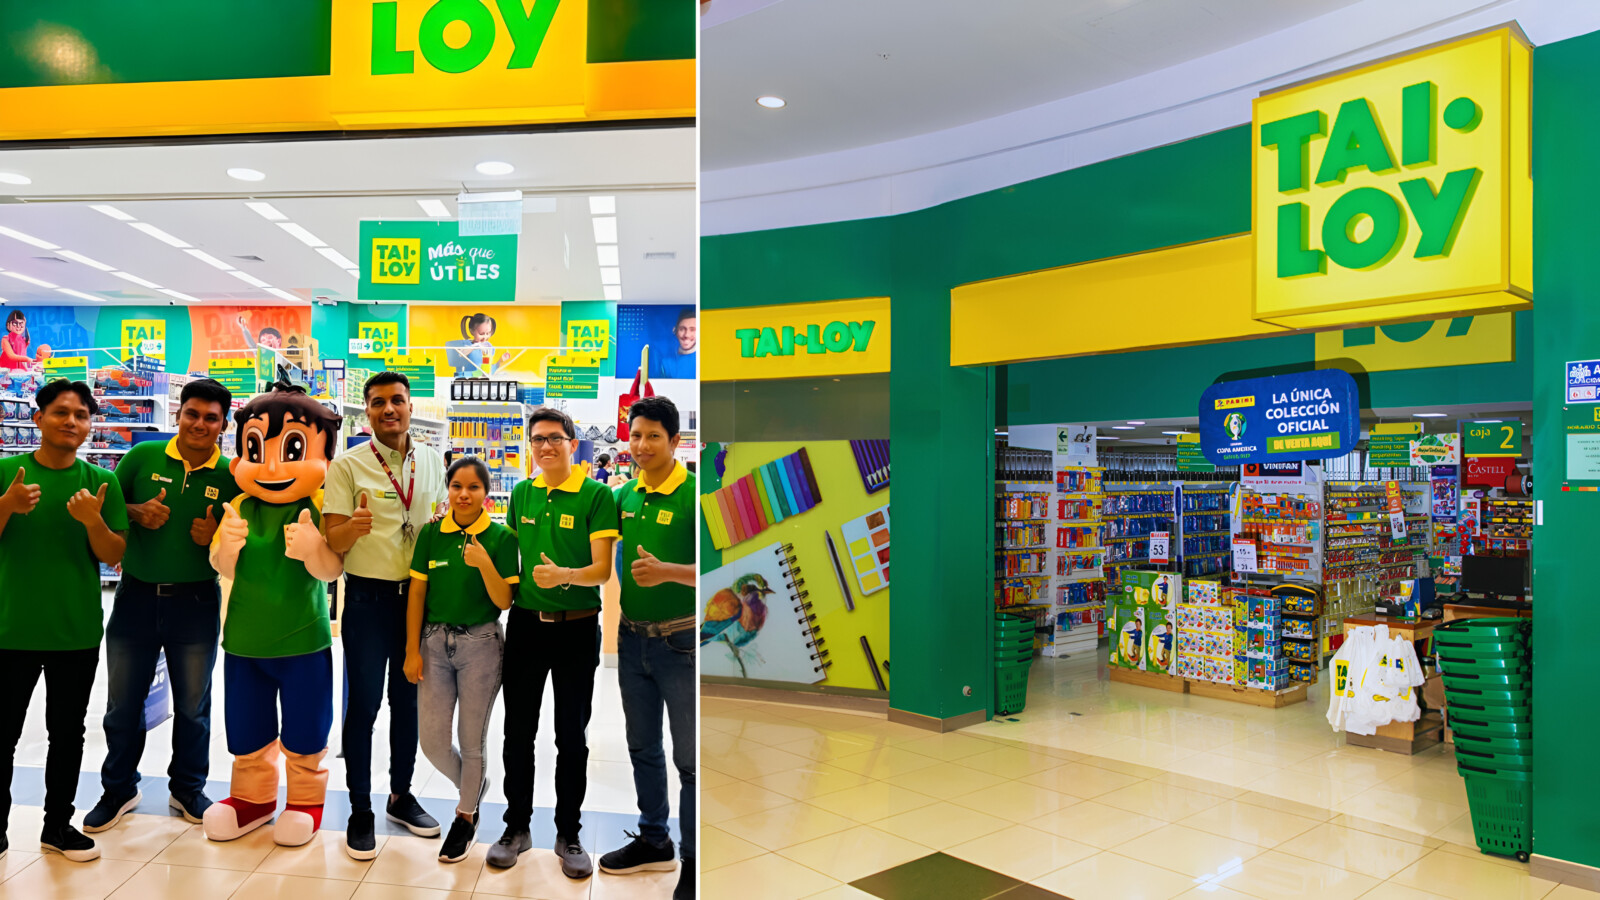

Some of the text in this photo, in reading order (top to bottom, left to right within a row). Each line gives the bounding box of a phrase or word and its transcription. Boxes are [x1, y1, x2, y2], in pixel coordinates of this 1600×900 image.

[371, 0, 560, 75] LOY
[1277, 167, 1484, 281] LOY
[427, 241, 496, 265] Más que
[379, 261, 416, 277] LOY
[373, 340, 393, 353] OY
[573, 340, 604, 352] LOY
[1225, 397, 1253, 405] PANINI
[1272, 387, 1332, 404] LA ÚNICA
[1265, 400, 1340, 420] COLECCIÓN
[1277, 418, 1329, 433] OFICIAL
[1470, 426, 1514, 449] caja 2
[1263, 462, 1299, 470] VINIFAN
[1468, 463, 1506, 474] CASTELL
[1153, 544, 1164, 556] 53
[1336, 665, 1348, 677] TA
